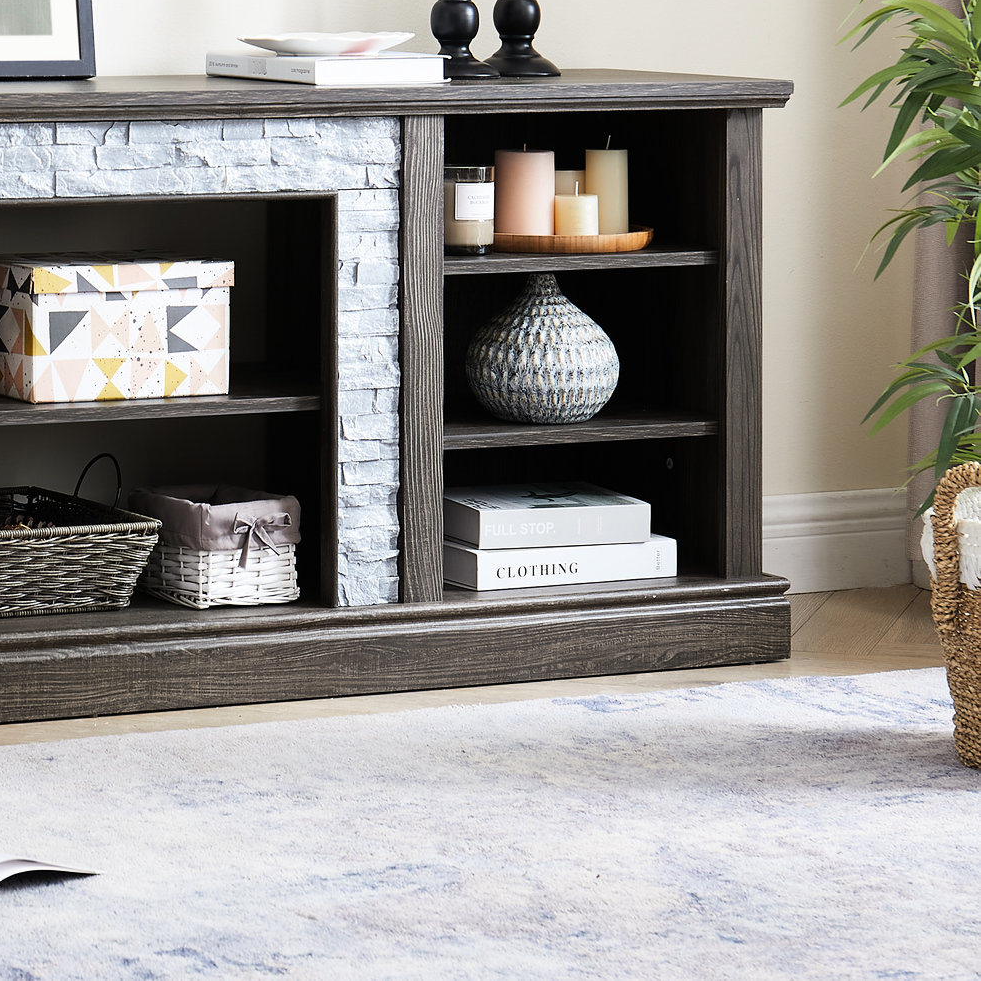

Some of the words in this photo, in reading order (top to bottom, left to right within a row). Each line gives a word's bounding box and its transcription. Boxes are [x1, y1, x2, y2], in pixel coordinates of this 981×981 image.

[484, 522, 517, 537] FULL
[519, 521, 556, 535] STOP.
[496, 561, 579, 580] CLOTHING
